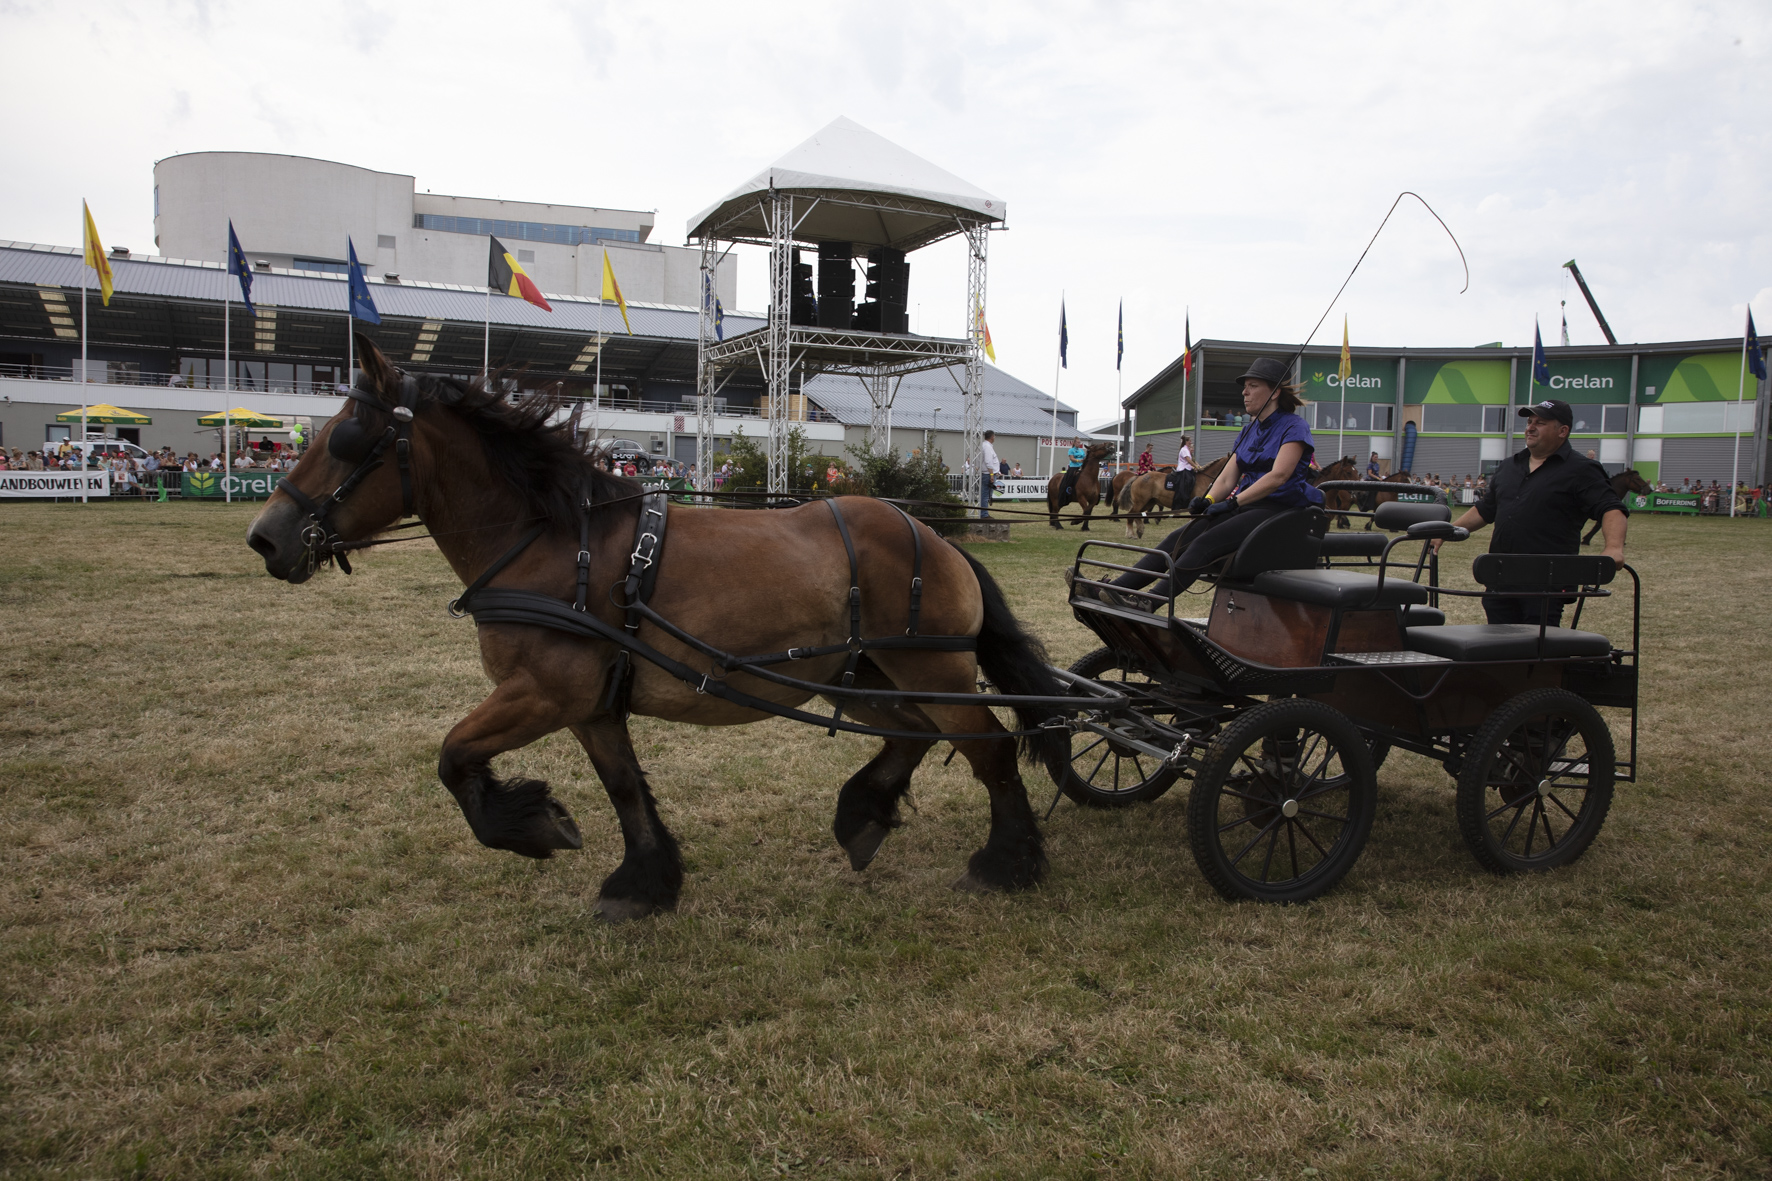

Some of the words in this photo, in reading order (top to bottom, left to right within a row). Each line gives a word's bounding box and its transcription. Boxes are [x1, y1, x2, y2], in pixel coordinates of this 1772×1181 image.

[1326, 373, 1381, 388] Celan
[1549, 374, 1614, 389] Crelan
[1041, 438, 1058, 446] POSE
[1007, 485, 1015, 494] LE
[1656, 498, 1697, 507] BOFFERDING
